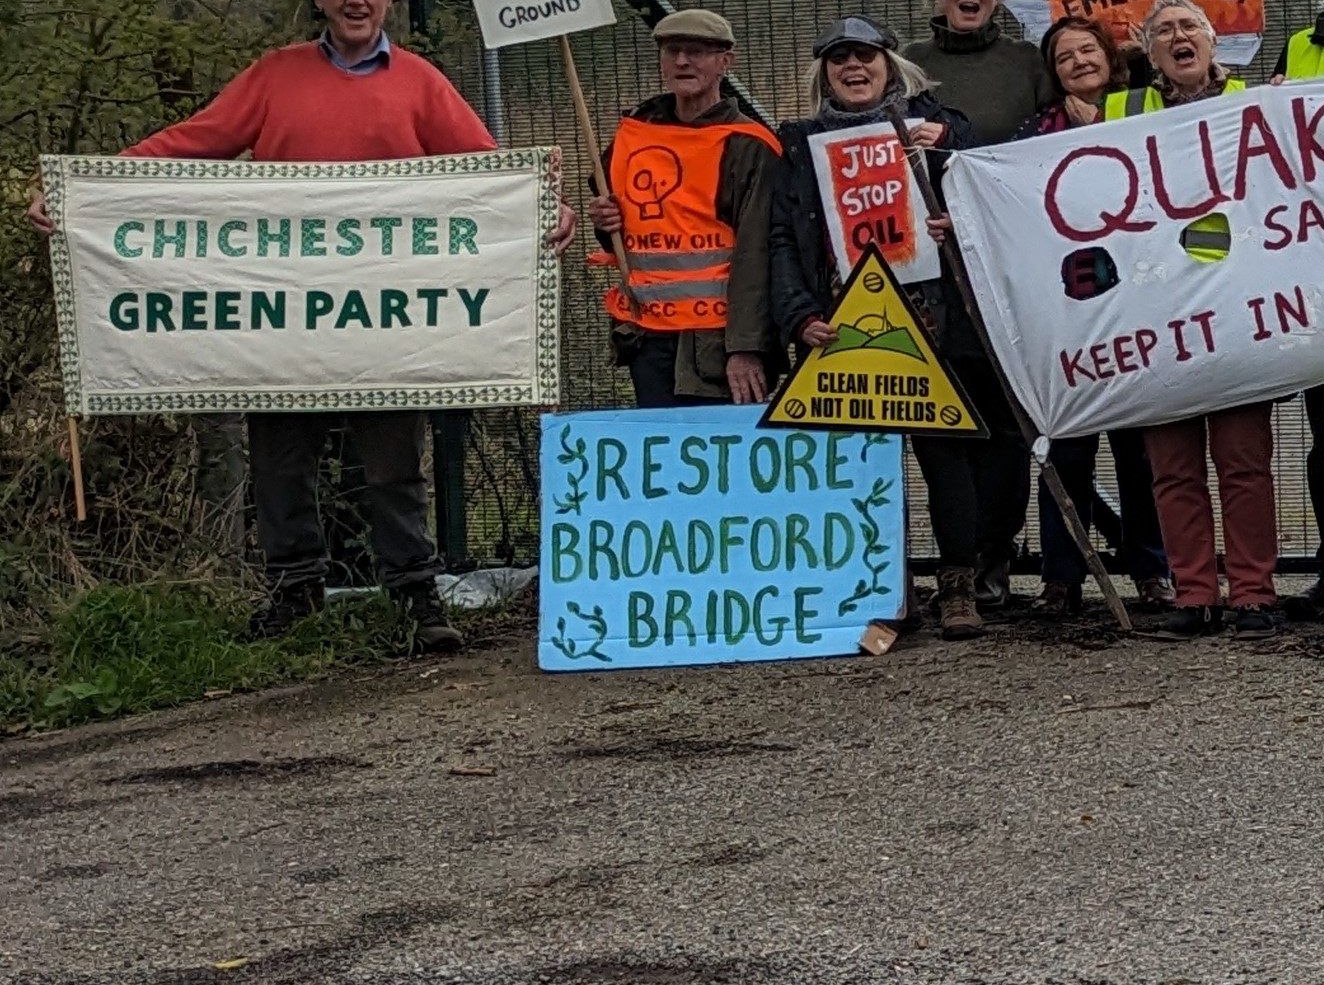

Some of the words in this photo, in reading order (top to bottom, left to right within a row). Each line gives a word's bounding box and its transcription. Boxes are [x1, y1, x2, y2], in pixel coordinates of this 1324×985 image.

[840, 139, 899, 179] JUST
[841, 180, 903, 216] STOP
[112, 216, 480, 259] CHICHESTER
[689, 232, 726, 249] OIL
[851, 215, 904, 252] OIL
[108, 290, 287, 333] GREEN
[304, 287, 491, 330] PARTY
[1059, 327, 1158, 387] KEEP
[1167, 310, 1216, 362] IT
[1246, 285, 1310, 342] IN
[817, 372, 869, 395] CLEAN
[874, 374, 930, 398] FIELDS
[810, 396, 847, 419] NOT
[850, 398, 876, 421] OIL
[881, 400, 936, 423] FIELDS
[596, 431, 855, 502] RESTORE
[552, 512, 856, 584] BROADFORD
[627, 585, 824, 649] BRIDGE
